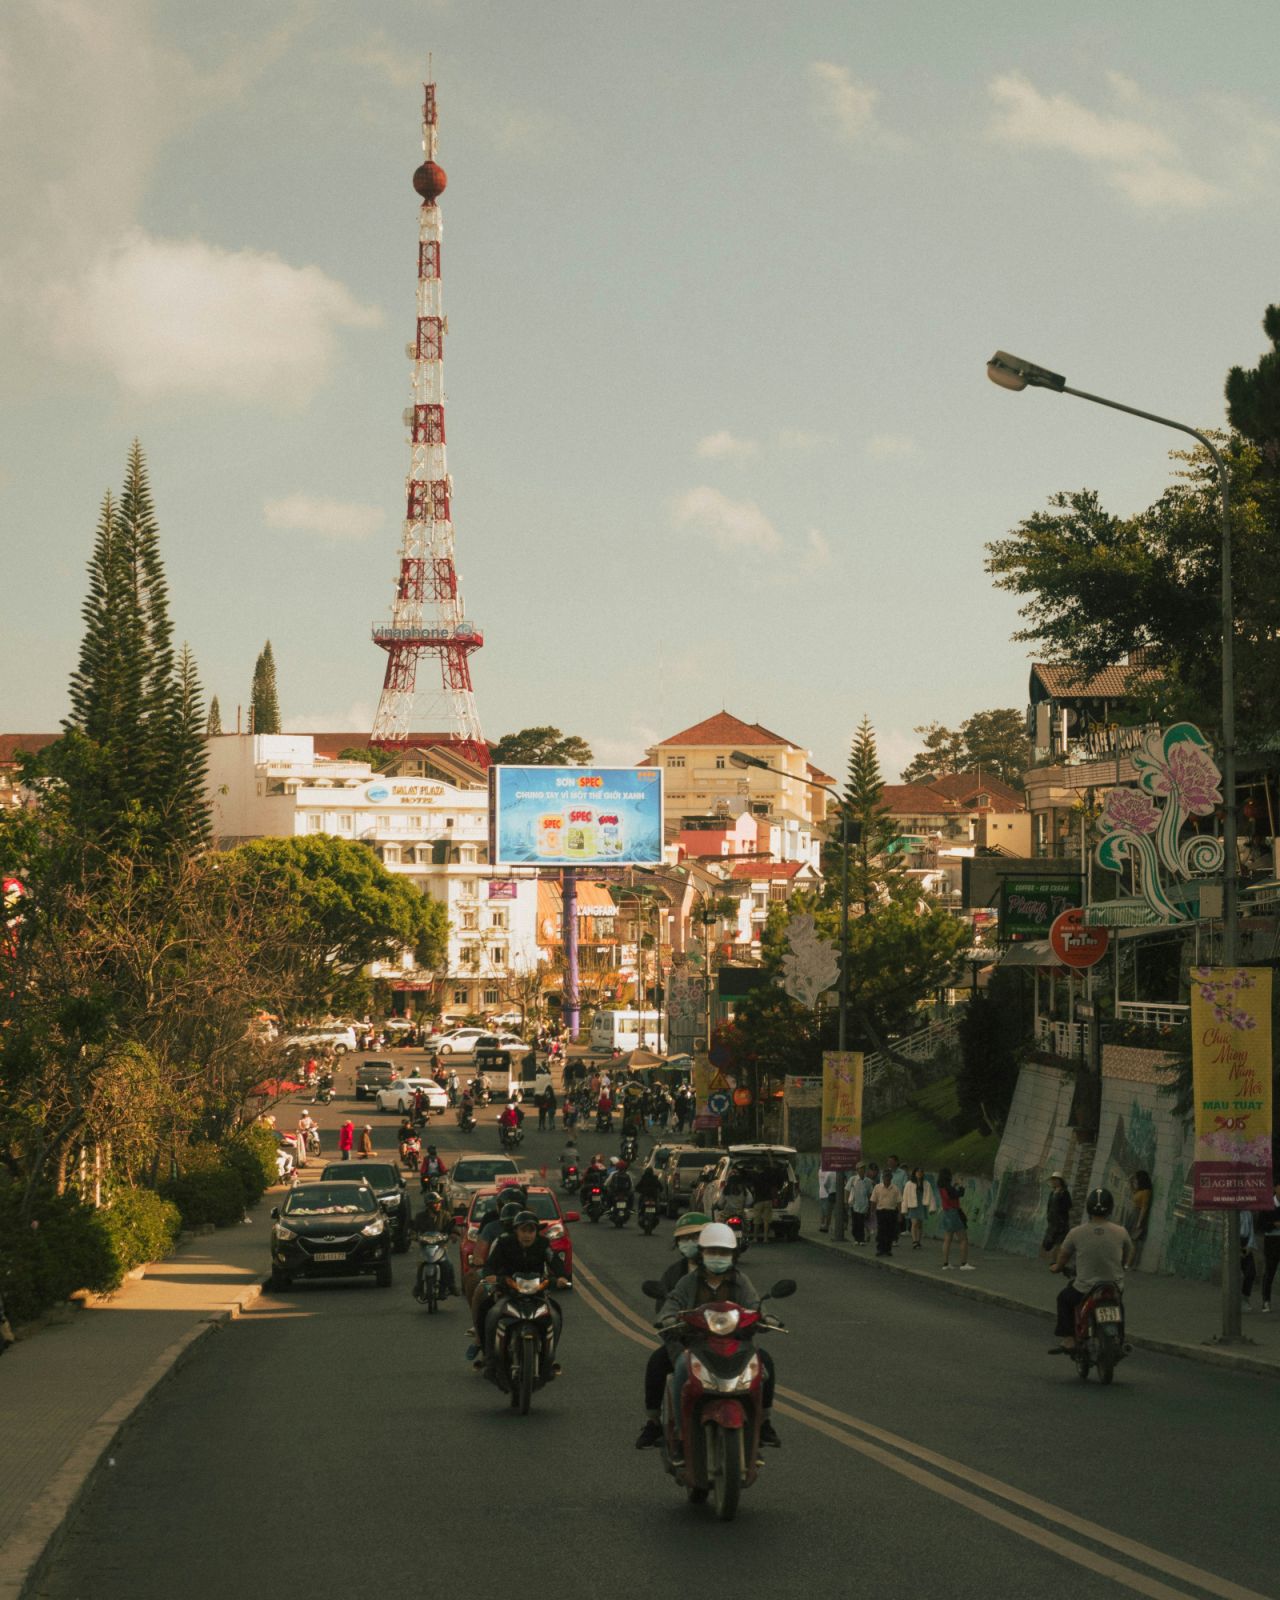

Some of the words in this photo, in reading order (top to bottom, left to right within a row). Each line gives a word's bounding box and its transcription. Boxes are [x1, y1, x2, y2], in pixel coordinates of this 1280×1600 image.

[371, 625, 449, 639] vinaphone
[579, 776, 601, 788] SPEC
[570, 811, 592, 823] SPEC
[543, 819, 561, 829] SPEC
[1212, 1179, 1266, 1188] AGRIBANK
